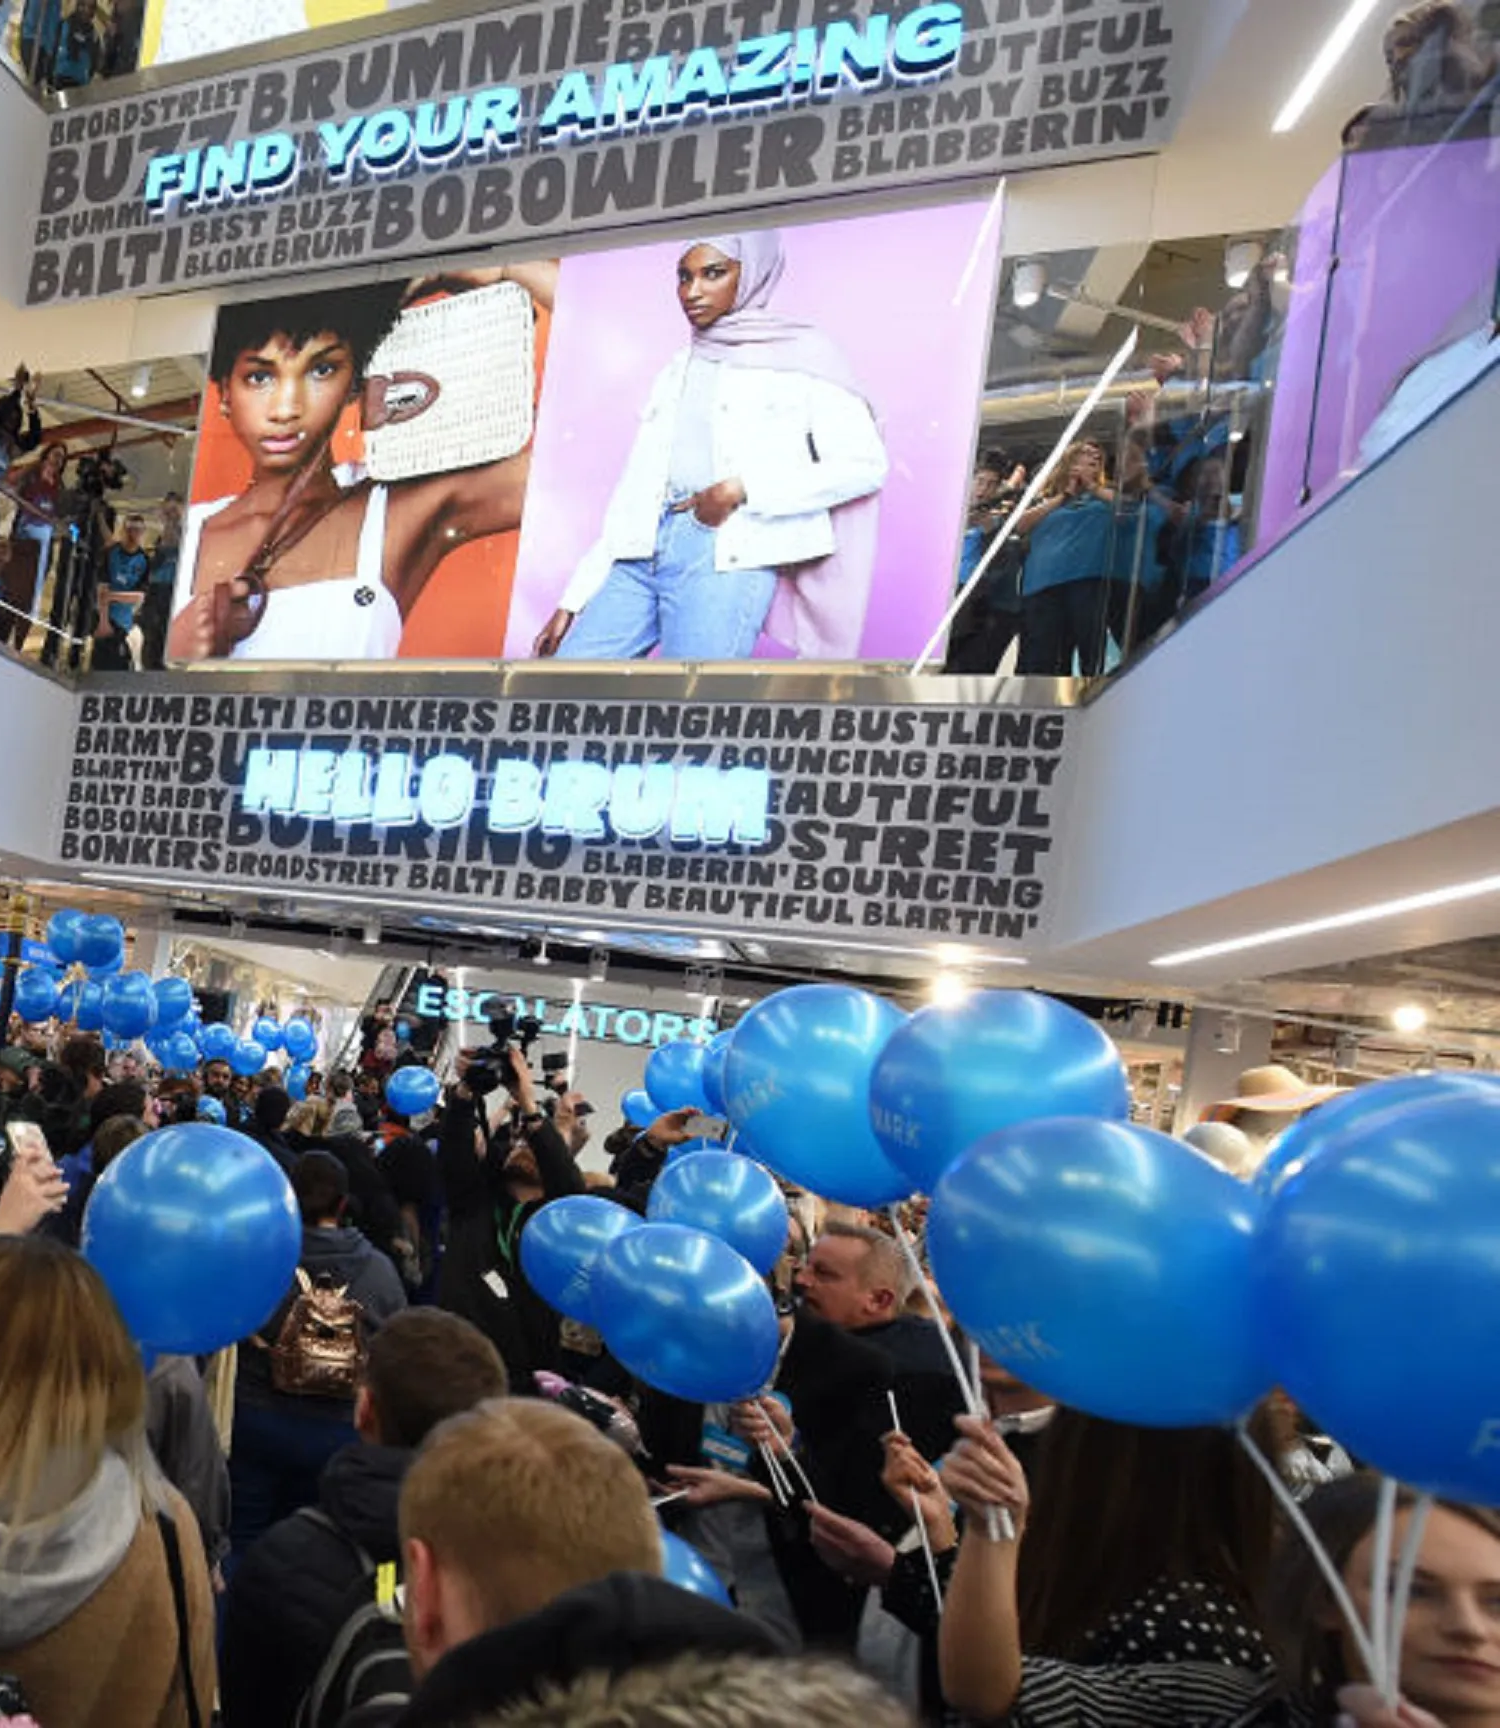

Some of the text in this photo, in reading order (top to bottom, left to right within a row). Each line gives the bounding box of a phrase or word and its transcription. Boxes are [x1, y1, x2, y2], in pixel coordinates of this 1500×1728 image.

[249, 0, 613, 133] BRUMMIE
[50, 78, 249, 147] BROADSTREET
[837, 79, 1022, 142] BARMY
[1039, 57, 1167, 109] BUZZ
[144, 132, 298, 210] FIND
[317, 86, 521, 172] YOUR
[832, 97, 1171, 182] BLABBERIN'
[372, 114, 826, 249] BOBOWLER
[189, 210, 268, 248] BEST
[276, 189, 375, 235] BUZZ
[26, 226, 183, 305] BALTI
[184, 225, 366, 279] BLOKE BRUM
[75, 726, 184, 757] BARMY
[80, 696, 1064, 750] BRUM BALTI BONKERS BIRMINGHAM BUSTLING
[72, 758, 180, 782] BLARTIN'
[721, 744, 928, 779] BOUNCING
[936, 753, 1061, 785] BABBY
[64, 805, 223, 839] BOBOWLER
[68, 781, 229, 811] BALTI BABBY
[242, 748, 770, 844] HELLO BRUM
[766, 778, 1050, 828] EAUTIFUL
[61, 832, 221, 871] BONKERS
[583, 851, 1043, 909] BLABBERIN' BOUNCING
[224, 851, 1038, 938] BROADSTREET BALTI BABBY BEAUTIFUL BLARTIN'
